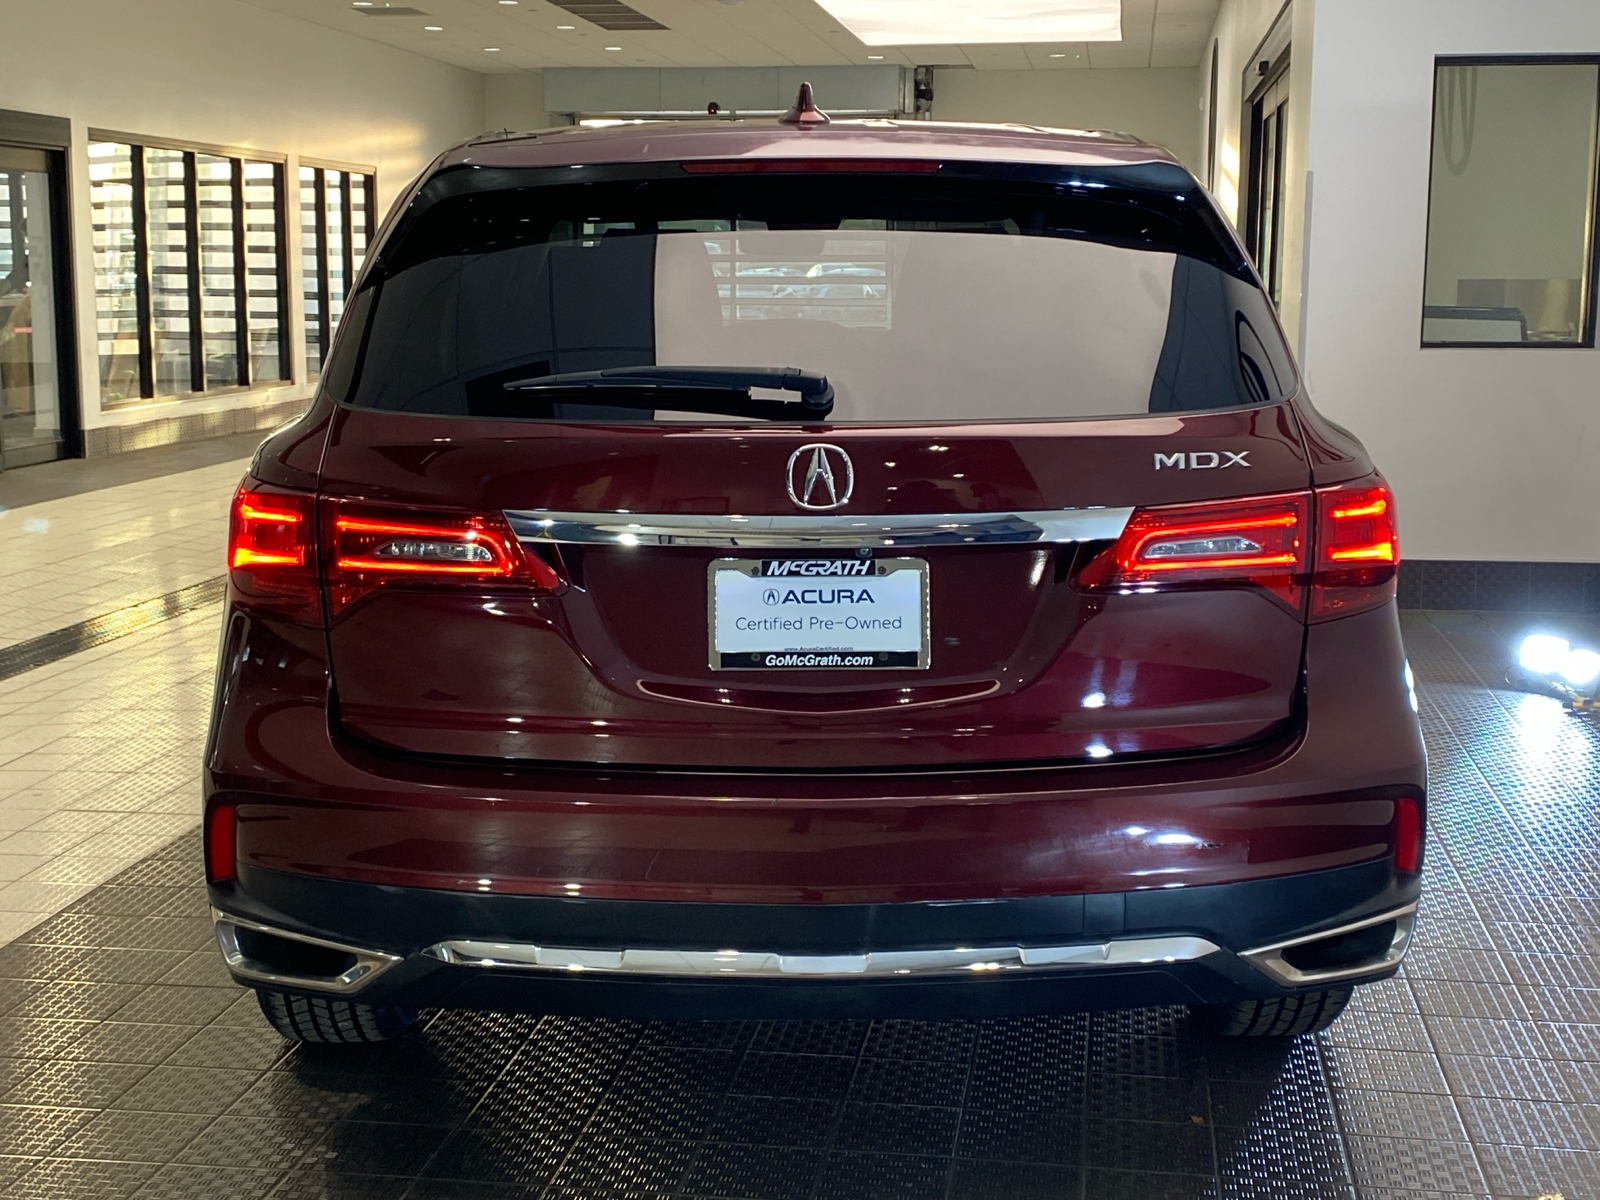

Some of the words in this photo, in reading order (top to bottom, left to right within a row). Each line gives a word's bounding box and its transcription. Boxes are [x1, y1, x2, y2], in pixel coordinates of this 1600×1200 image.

[1154, 451, 1251, 470] MDX
[782, 589, 875, 604] ACURA
[735, 617, 803, 631] Certified
[809, 616, 902, 630] Pre-Owned
[765, 654, 873, 667] GoMcGrath.com
